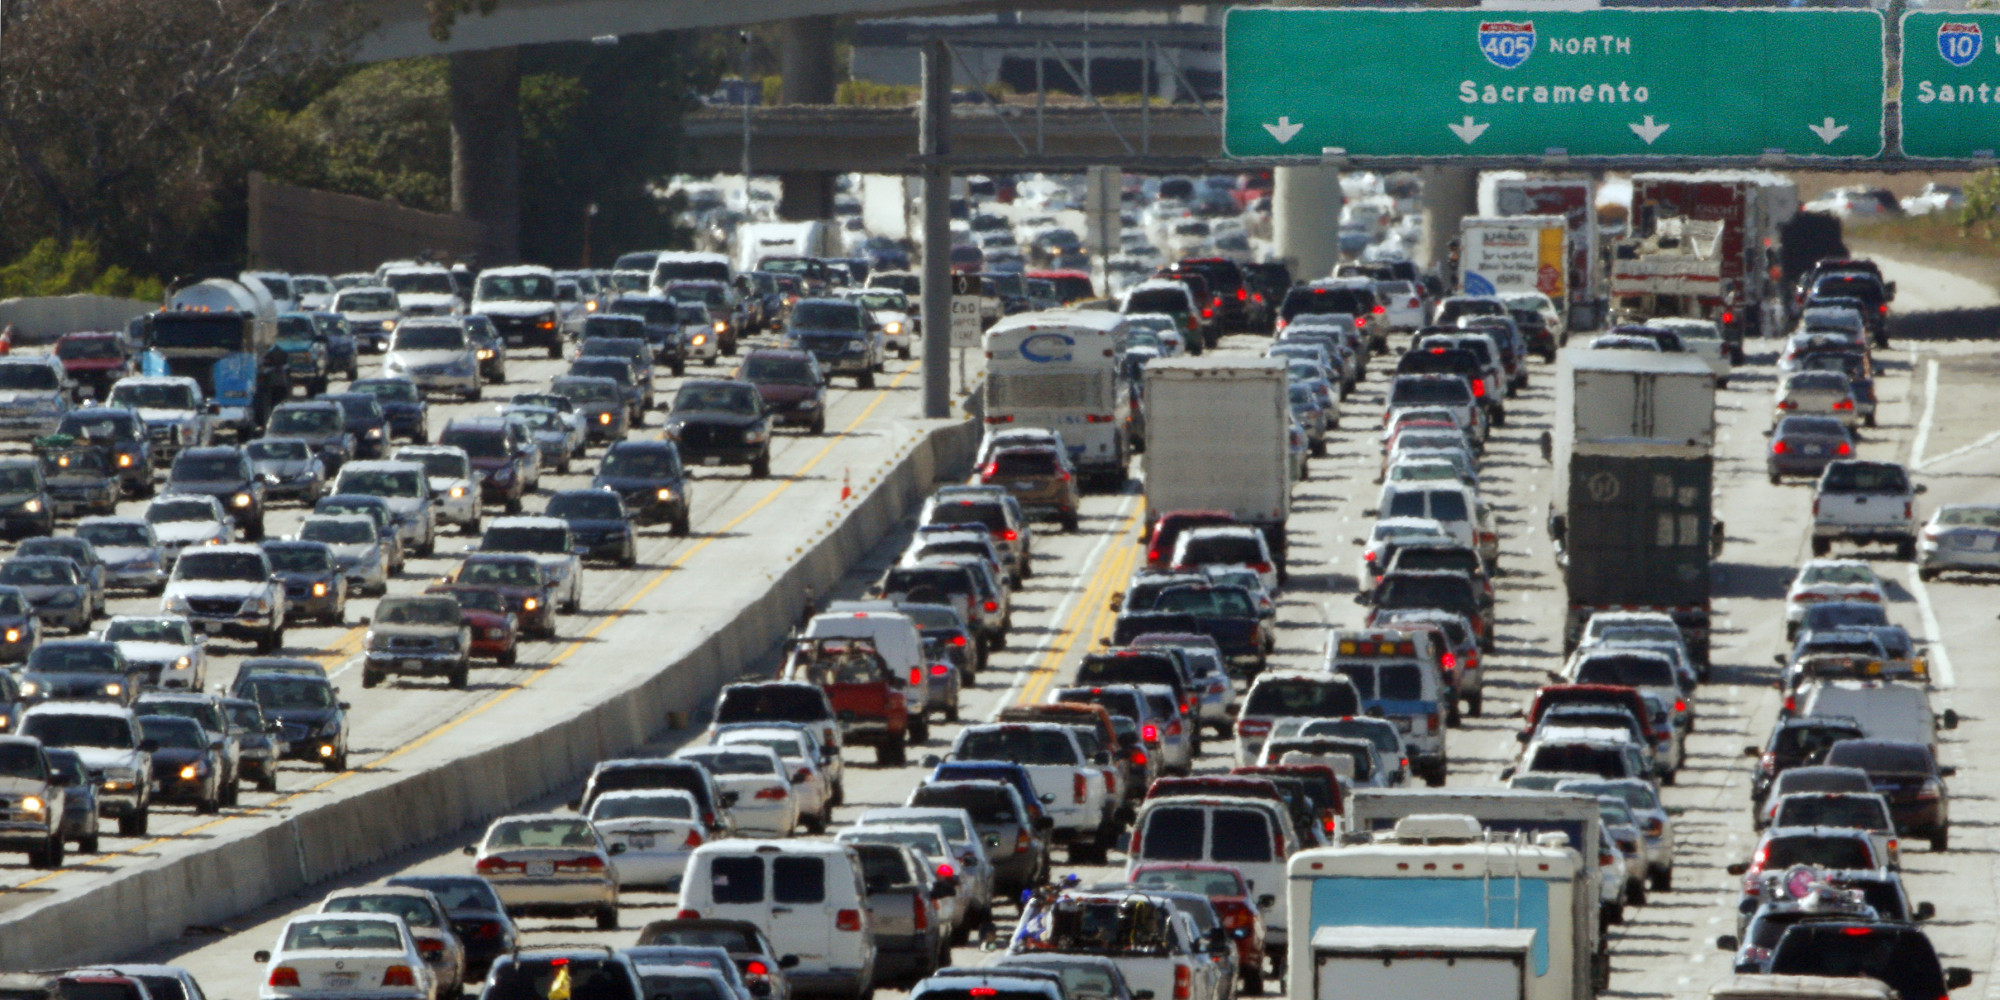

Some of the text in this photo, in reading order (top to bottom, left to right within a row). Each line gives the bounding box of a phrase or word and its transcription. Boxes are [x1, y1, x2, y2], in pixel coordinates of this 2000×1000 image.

[1485, 35, 1631, 57] 405 NORTH
[1948, 36, 1973, 57] 10
[1458, 80, 1649, 104] Sacramento
[952, 301, 976, 314] END
